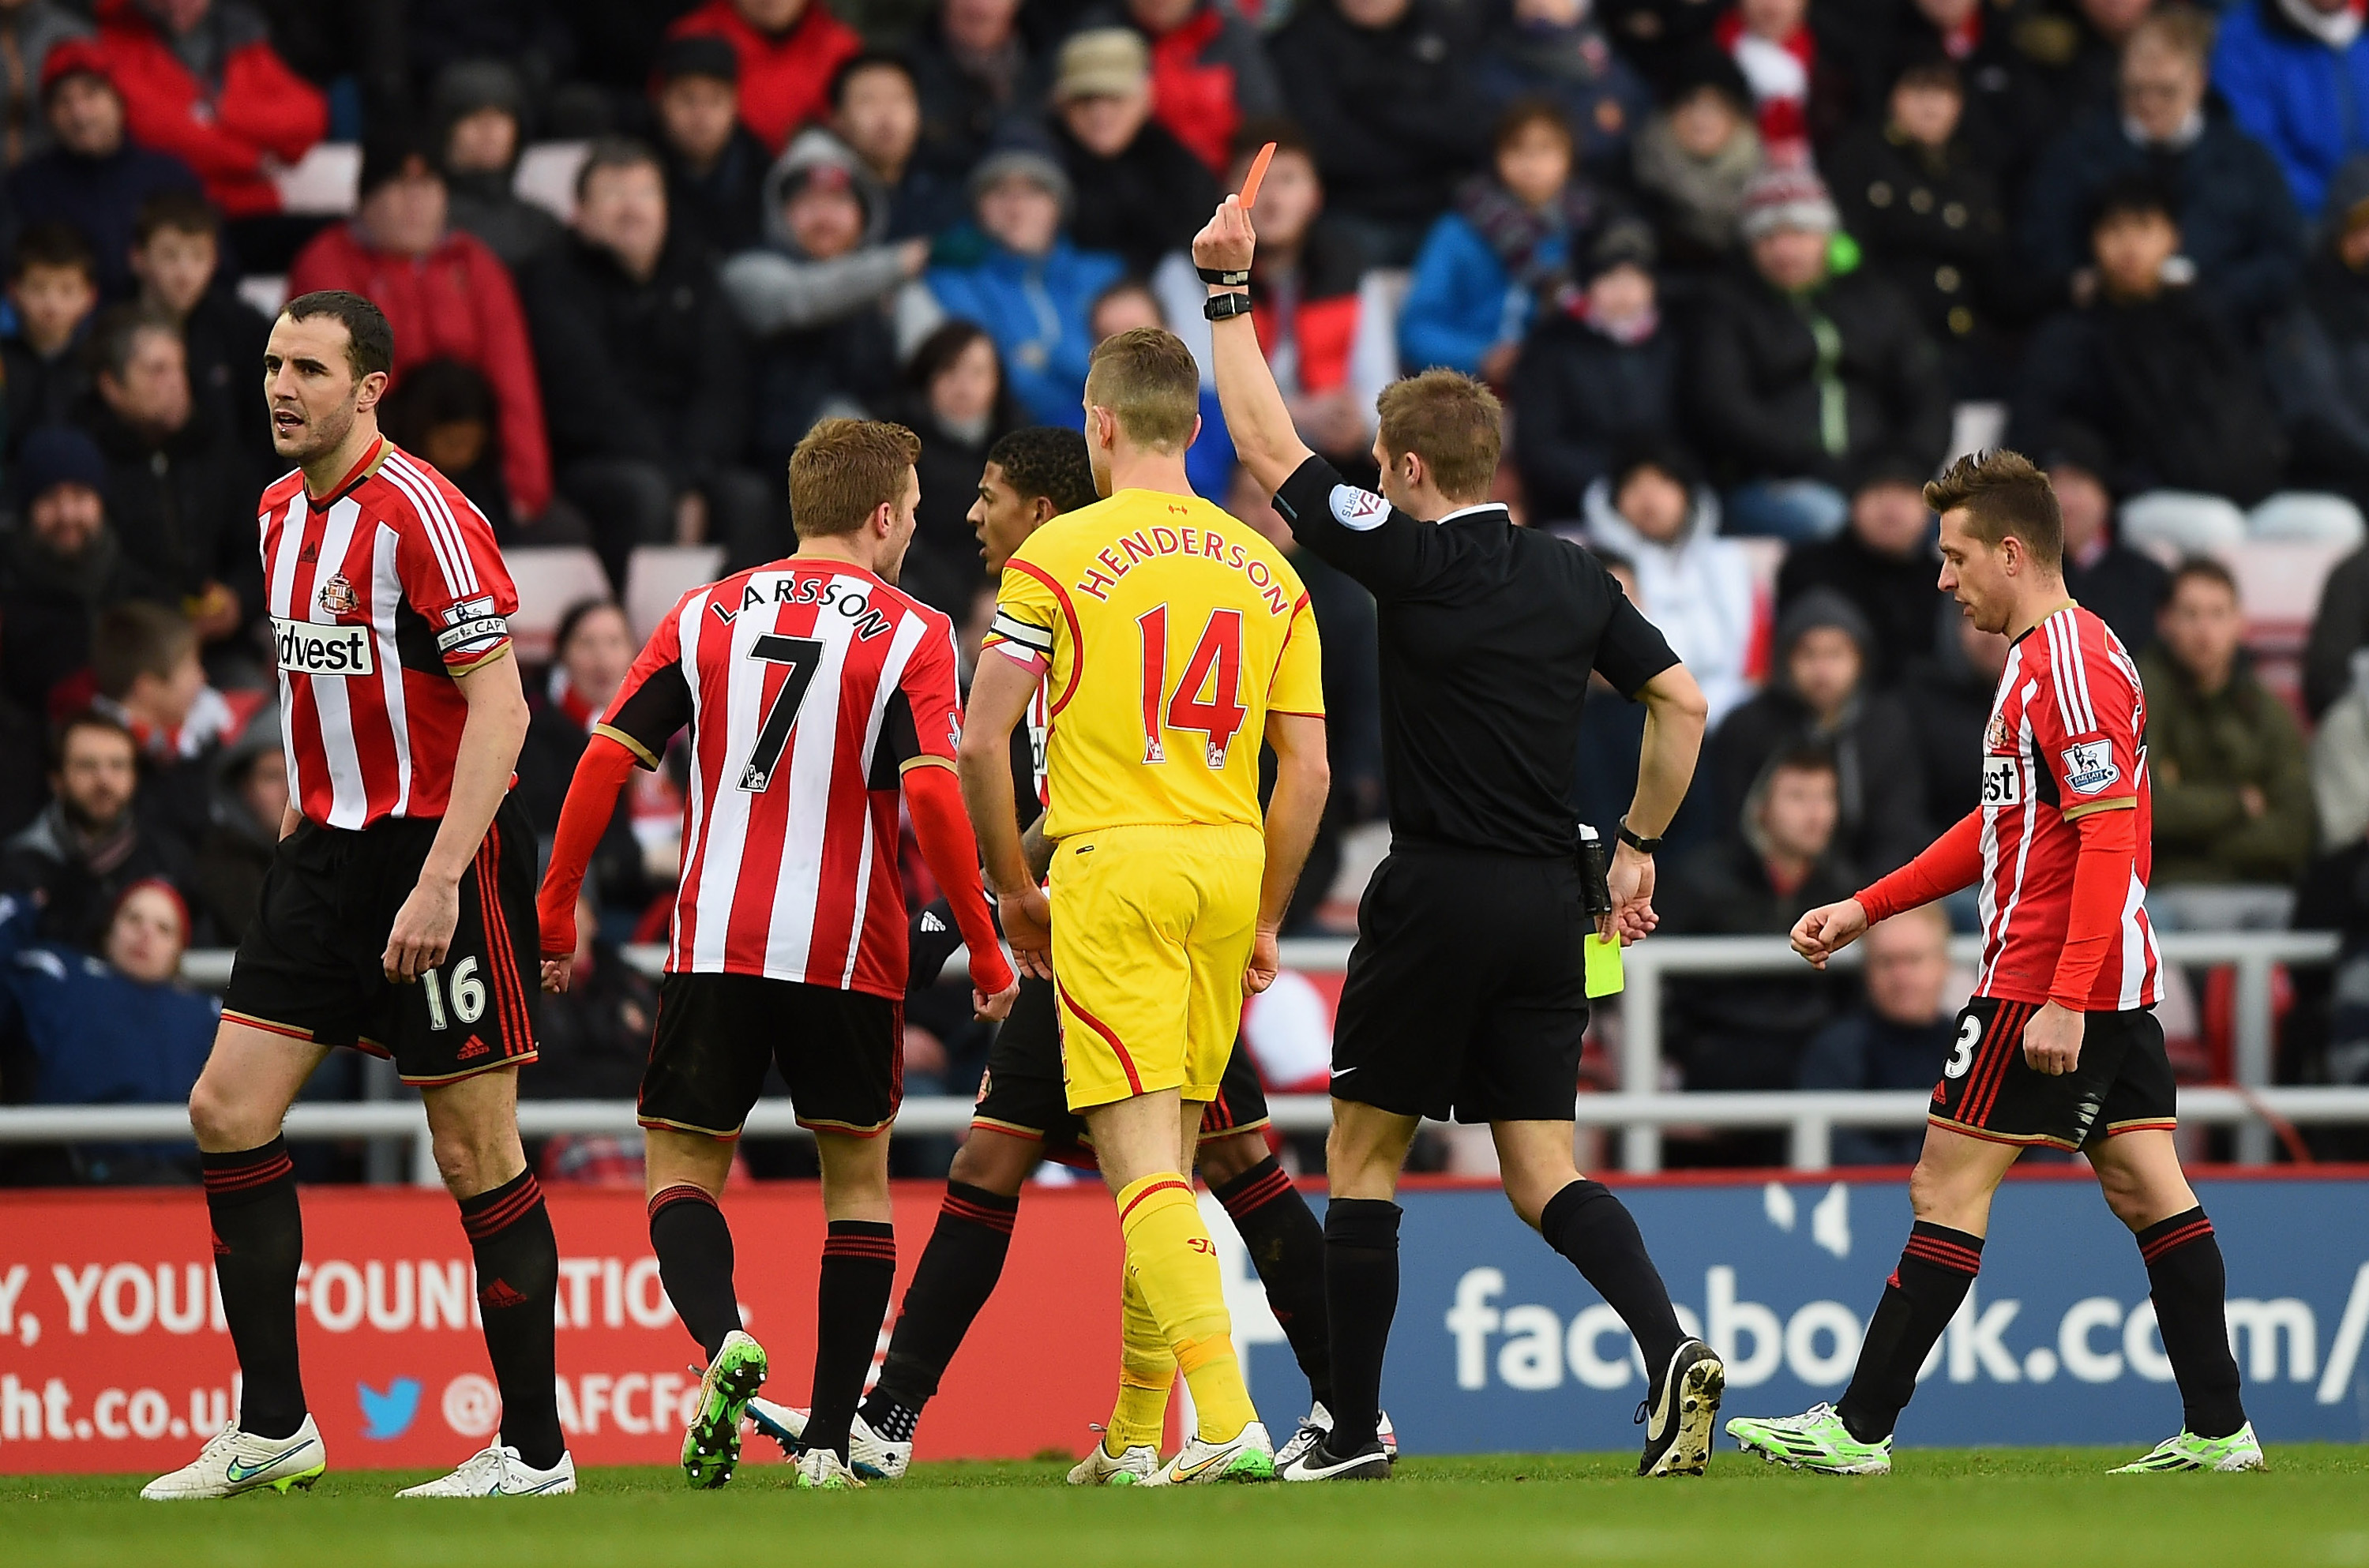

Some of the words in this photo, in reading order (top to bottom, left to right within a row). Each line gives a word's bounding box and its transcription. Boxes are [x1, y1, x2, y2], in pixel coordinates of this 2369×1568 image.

[1342, 490, 1361, 518] ORTS
[1077, 527, 1290, 617] HENDERSON
[273, 622, 364, 670] idvest
[711, 579, 891, 641] LARSSON
[737, 632, 826, 792] 7
[1135, 602, 1248, 769] 14
[421, 955, 486, 1030] 16
[1446, 1260, 2369, 1405] facbok.com/
[0, 1371, 241, 1441] ht.co.u
